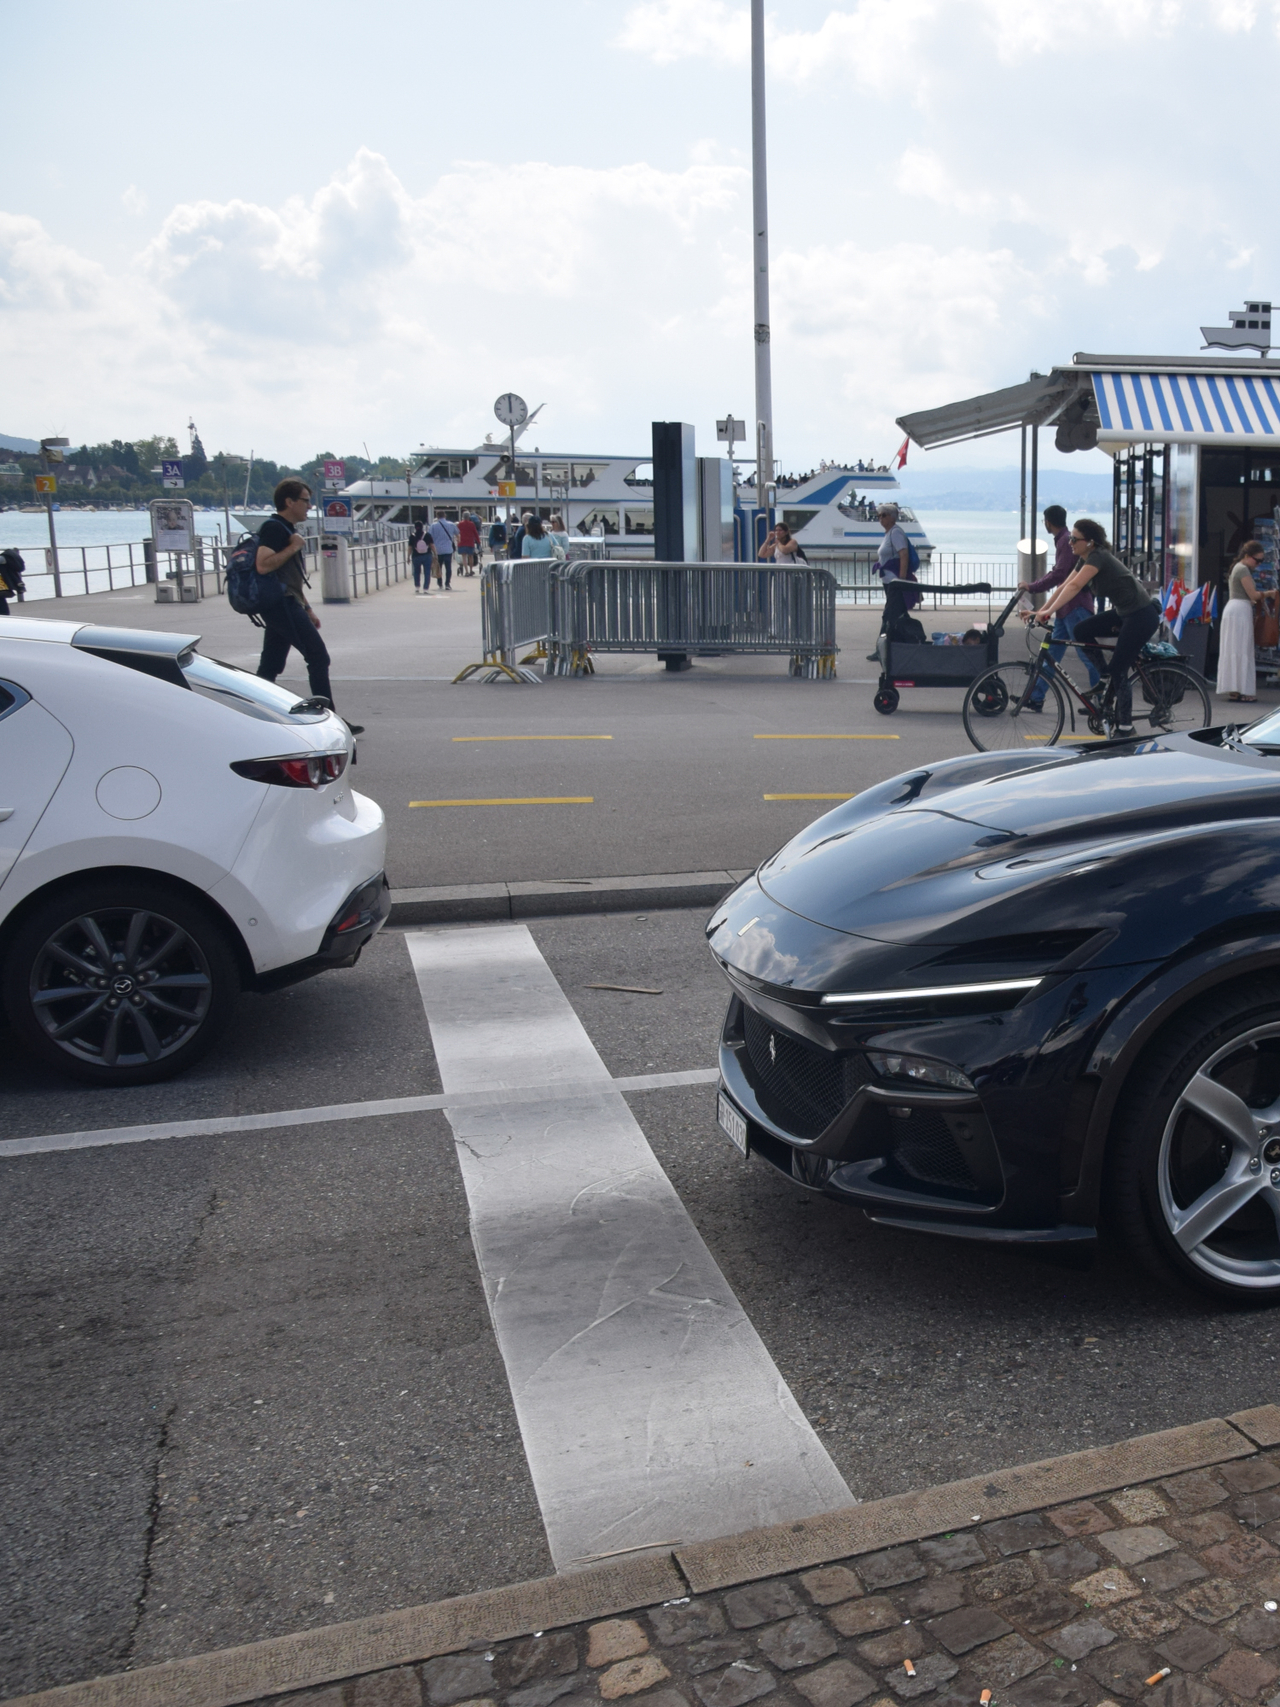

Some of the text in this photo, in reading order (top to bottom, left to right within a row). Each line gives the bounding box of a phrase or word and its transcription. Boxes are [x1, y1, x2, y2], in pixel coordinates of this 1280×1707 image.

[165, 465, 181, 476] 3A
[328, 465, 342, 476] 3B
[42, 480, 51, 491] 2
